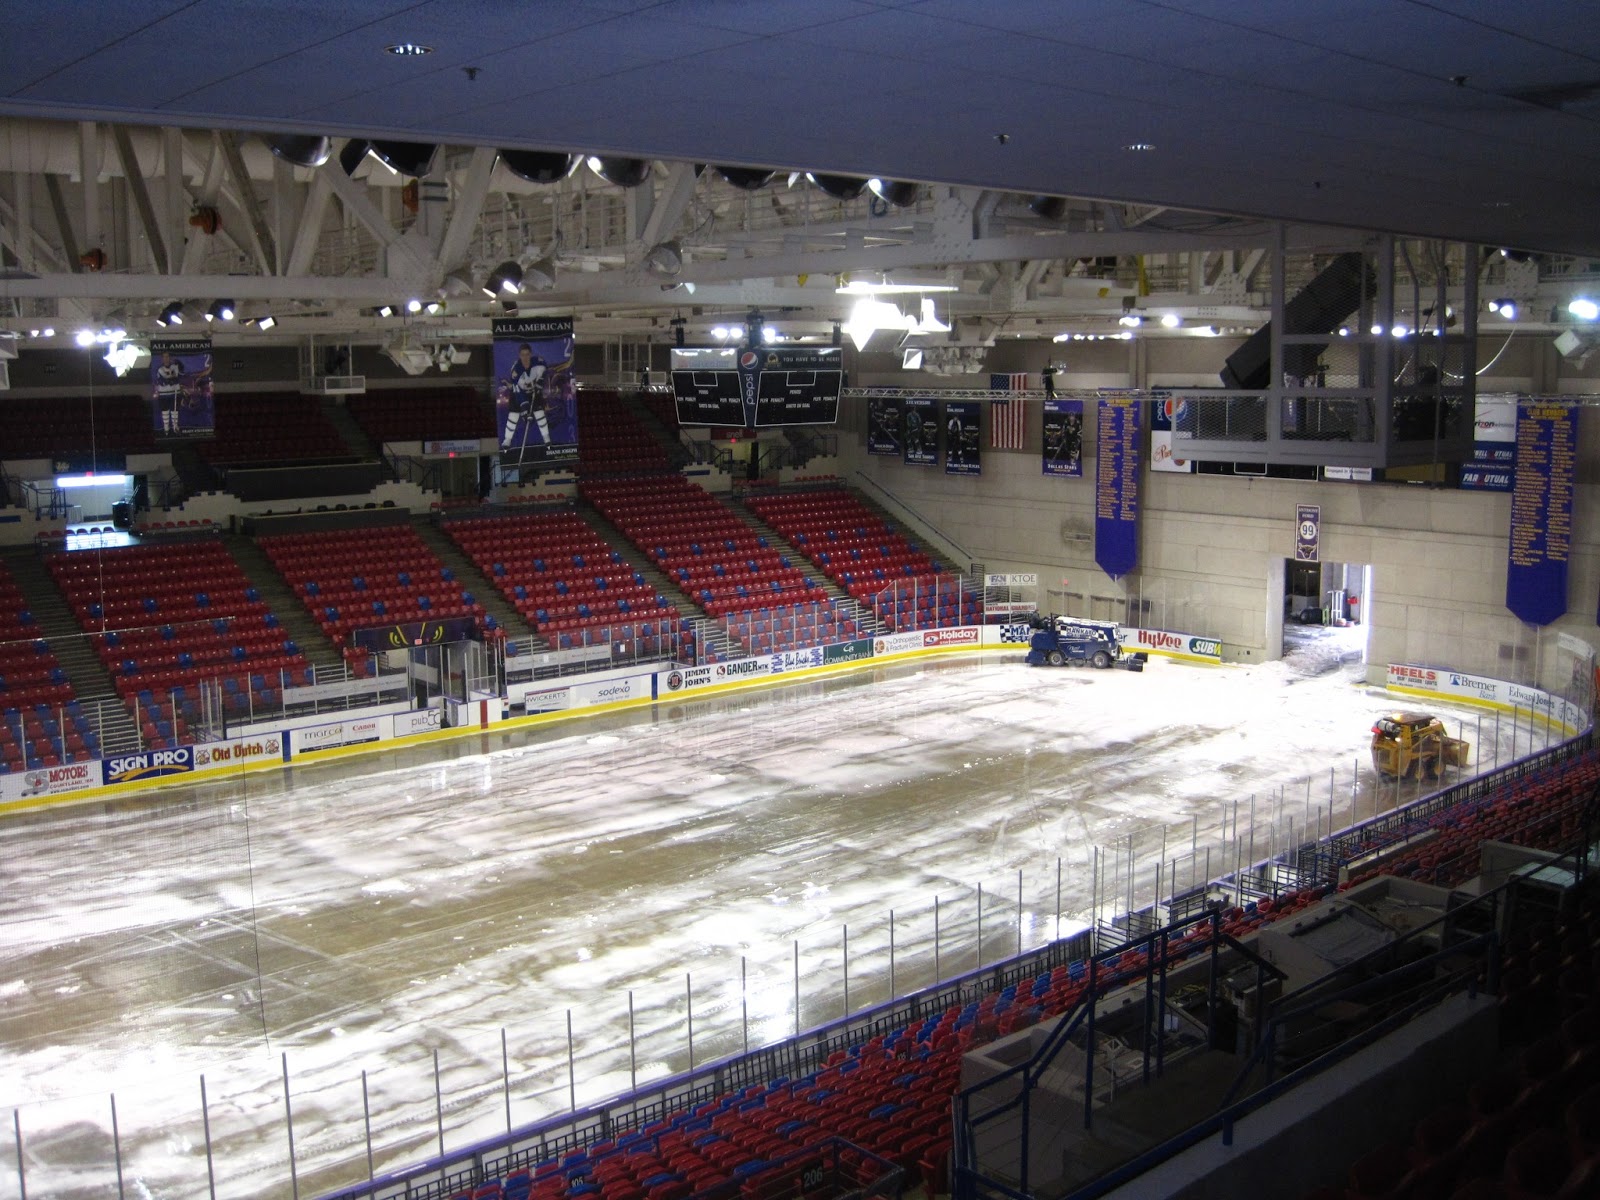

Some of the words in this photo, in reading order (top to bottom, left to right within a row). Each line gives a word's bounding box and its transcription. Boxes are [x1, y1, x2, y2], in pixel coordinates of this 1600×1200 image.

[495, 324, 515, 333] ALL
[518, 322, 571, 332] AMERICAN
[744, 373, 755, 405] pepsi
[1474, 420, 1495, 429] rizon
[1302, 524, 1314, 536] 99
[1011, 574, 1036, 583] KTOE
[940, 629, 977, 640] Holiday
[1066, 626, 1097, 637] MANKATO
[893, 635, 922, 645] Orthopaedic
[1138, 630, 1182, 648] HyVee
[824, 653, 858, 665] COMMUNITY
[858, 651, 872, 660] BANK
[685, 667, 712, 679] JIMMY
[727, 660, 758, 676] GANDER
[1388, 665, 1437, 681] HEELS
[685, 676, 711, 688] JOHN'S
[1461, 677, 1497, 692] Bremer
[598, 685, 631, 697] sodexo
[1479, 690, 1496, 701] Bank
[1509, 685, 1535, 702] Edward
[1536, 693, 1555, 709] Jones
[352, 722, 376, 732] Canon
[212, 747, 231, 762] Old
[234, 742, 264, 759] Dutch
[108, 755, 148, 776] SIGN
[153, 748, 189, 766] PRO
[49, 765, 89, 783] MOTORS
[803, 1166, 823, 1188] 206
